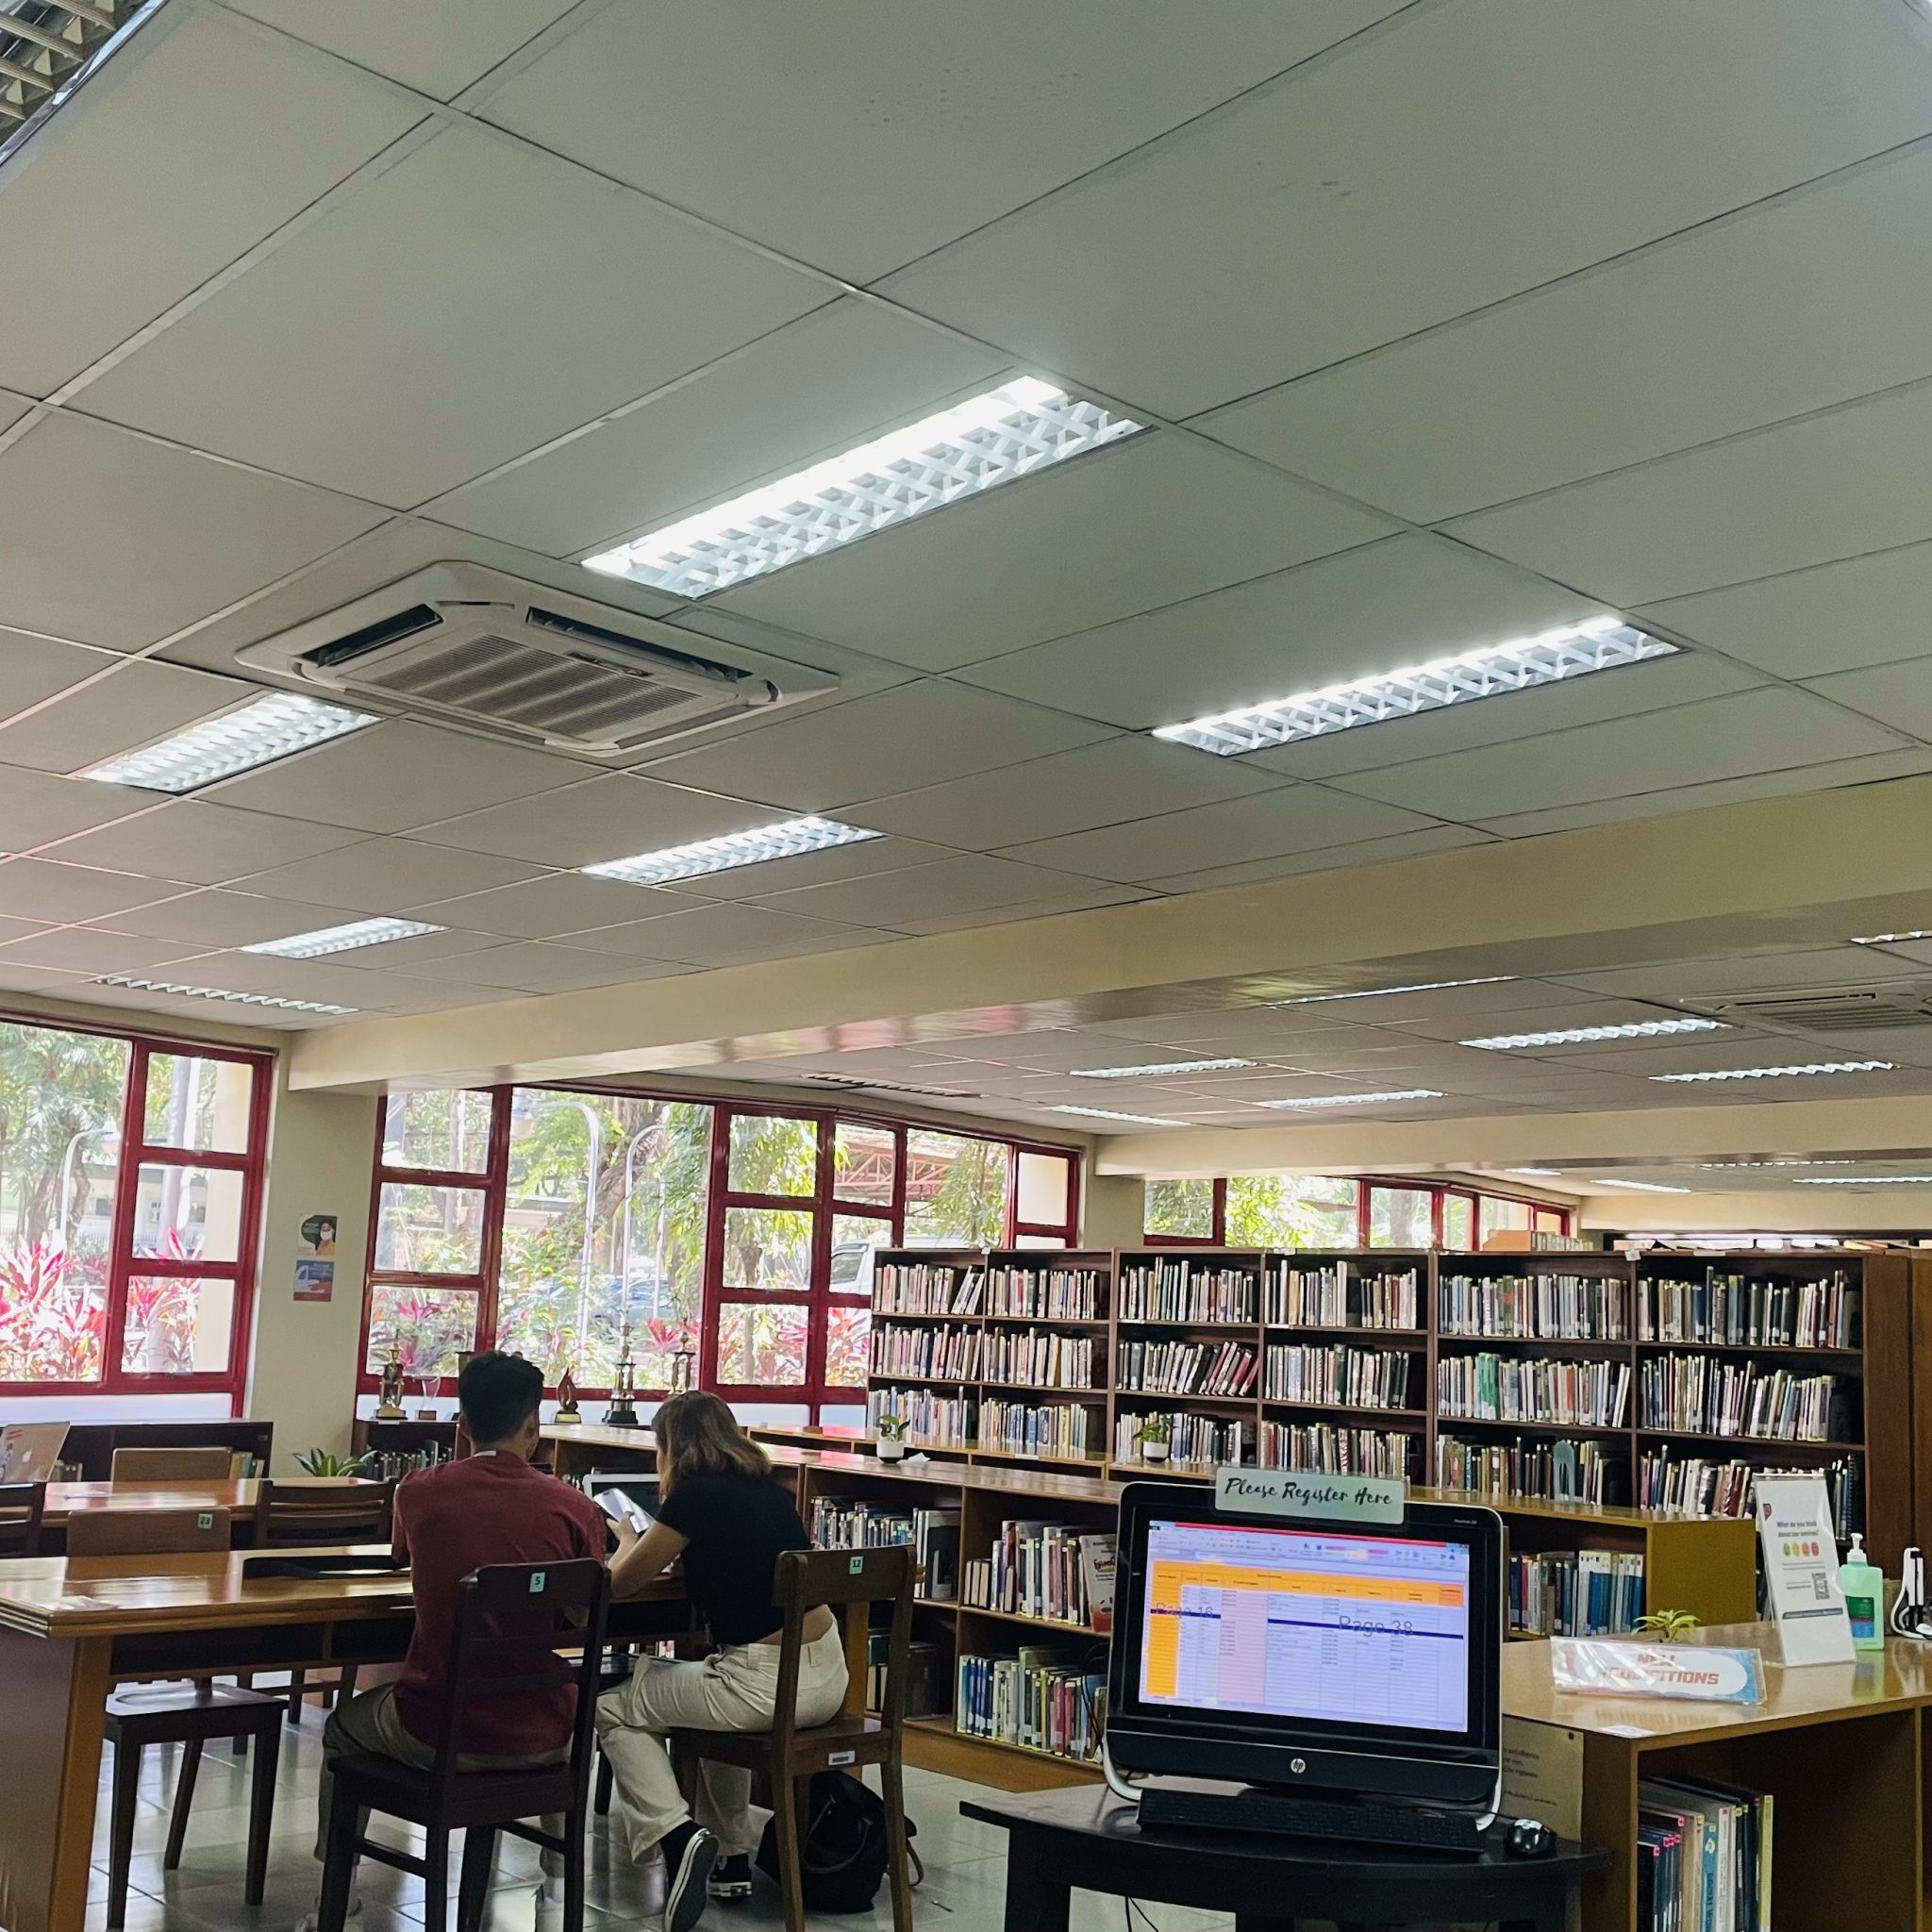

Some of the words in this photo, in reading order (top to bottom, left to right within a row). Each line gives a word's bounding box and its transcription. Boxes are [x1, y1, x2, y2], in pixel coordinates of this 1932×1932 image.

[1224, 1477, 1277, 1499] Please
[1281, 1482, 1349, 1507] Register
[1354, 1487, 1393, 1506] Here
[852, 1559, 861, 1568] 12
[535, 1575, 541, 1586] 5
[1197, 1607, 1214, 1618] 16
[1340, 1615, 1385, 1637] Page
[1391, 1620, 1413, 1636] 38
